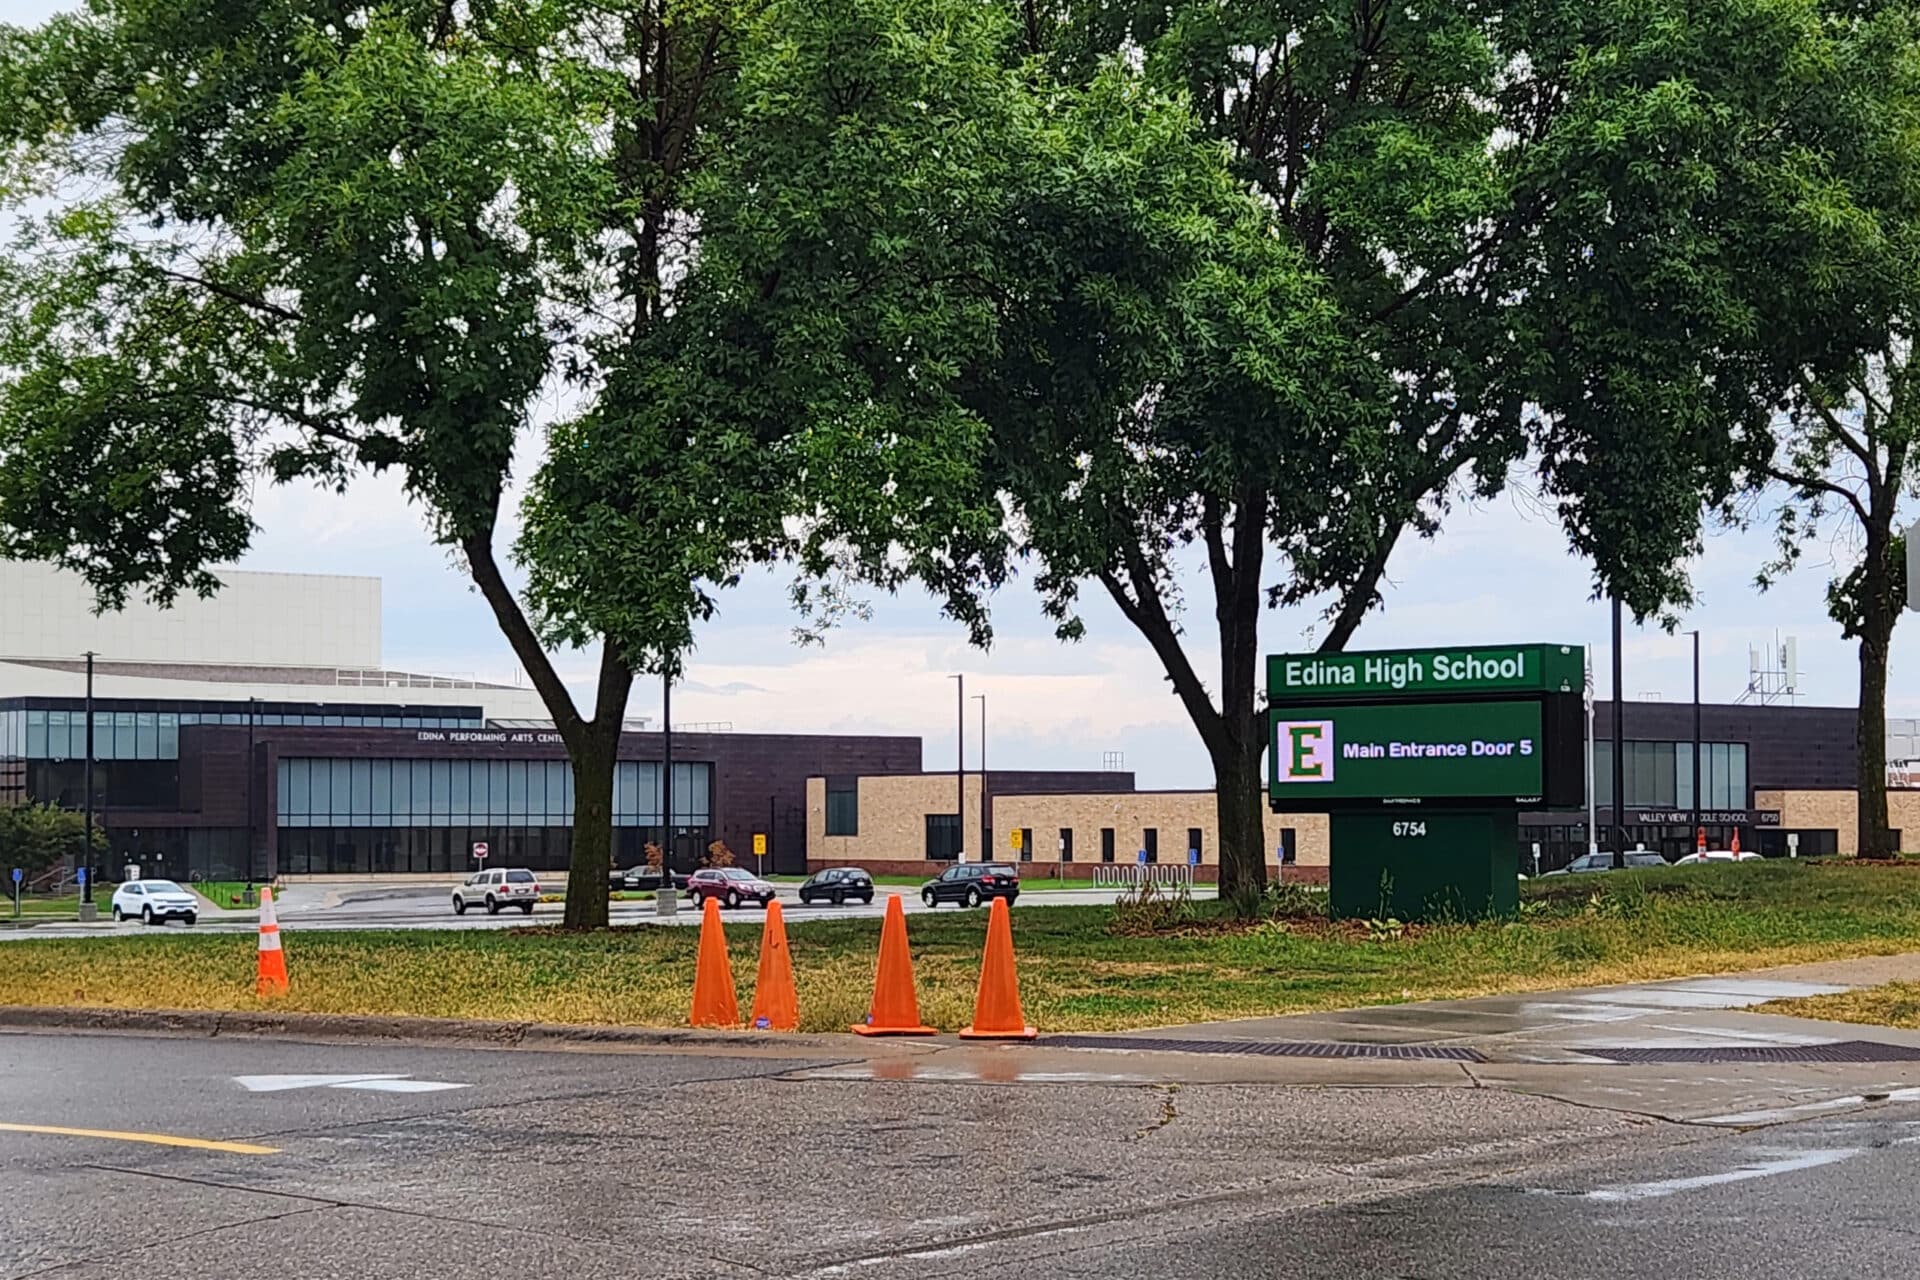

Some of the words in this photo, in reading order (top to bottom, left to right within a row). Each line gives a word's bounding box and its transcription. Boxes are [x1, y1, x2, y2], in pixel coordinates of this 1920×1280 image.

[1285, 661, 1356, 686] Edina
[1364, 656, 1423, 688] High
[1432, 653, 1524, 681] School
[417, 732, 446, 741] EDINA
[449, 732, 507, 742] PERFORMING
[510, 733, 534, 742] ARTS
[537, 733, 564, 743] CENTE
[1288, 724, 1323, 778] E
[1343, 742, 1385, 759] Main
[1389, 741, 1467, 758] Entrance
[1472, 740, 1516, 756] Door
[1519, 739, 1533, 755] 5
[1638, 813, 1666, 823] VALLEY
[1667, 813, 1687, 823] VIEW
[1718, 813, 1749, 823] SCHOOL
[1761, 813, 1779, 823] 6750
[1392, 821, 1427, 836] 6754
